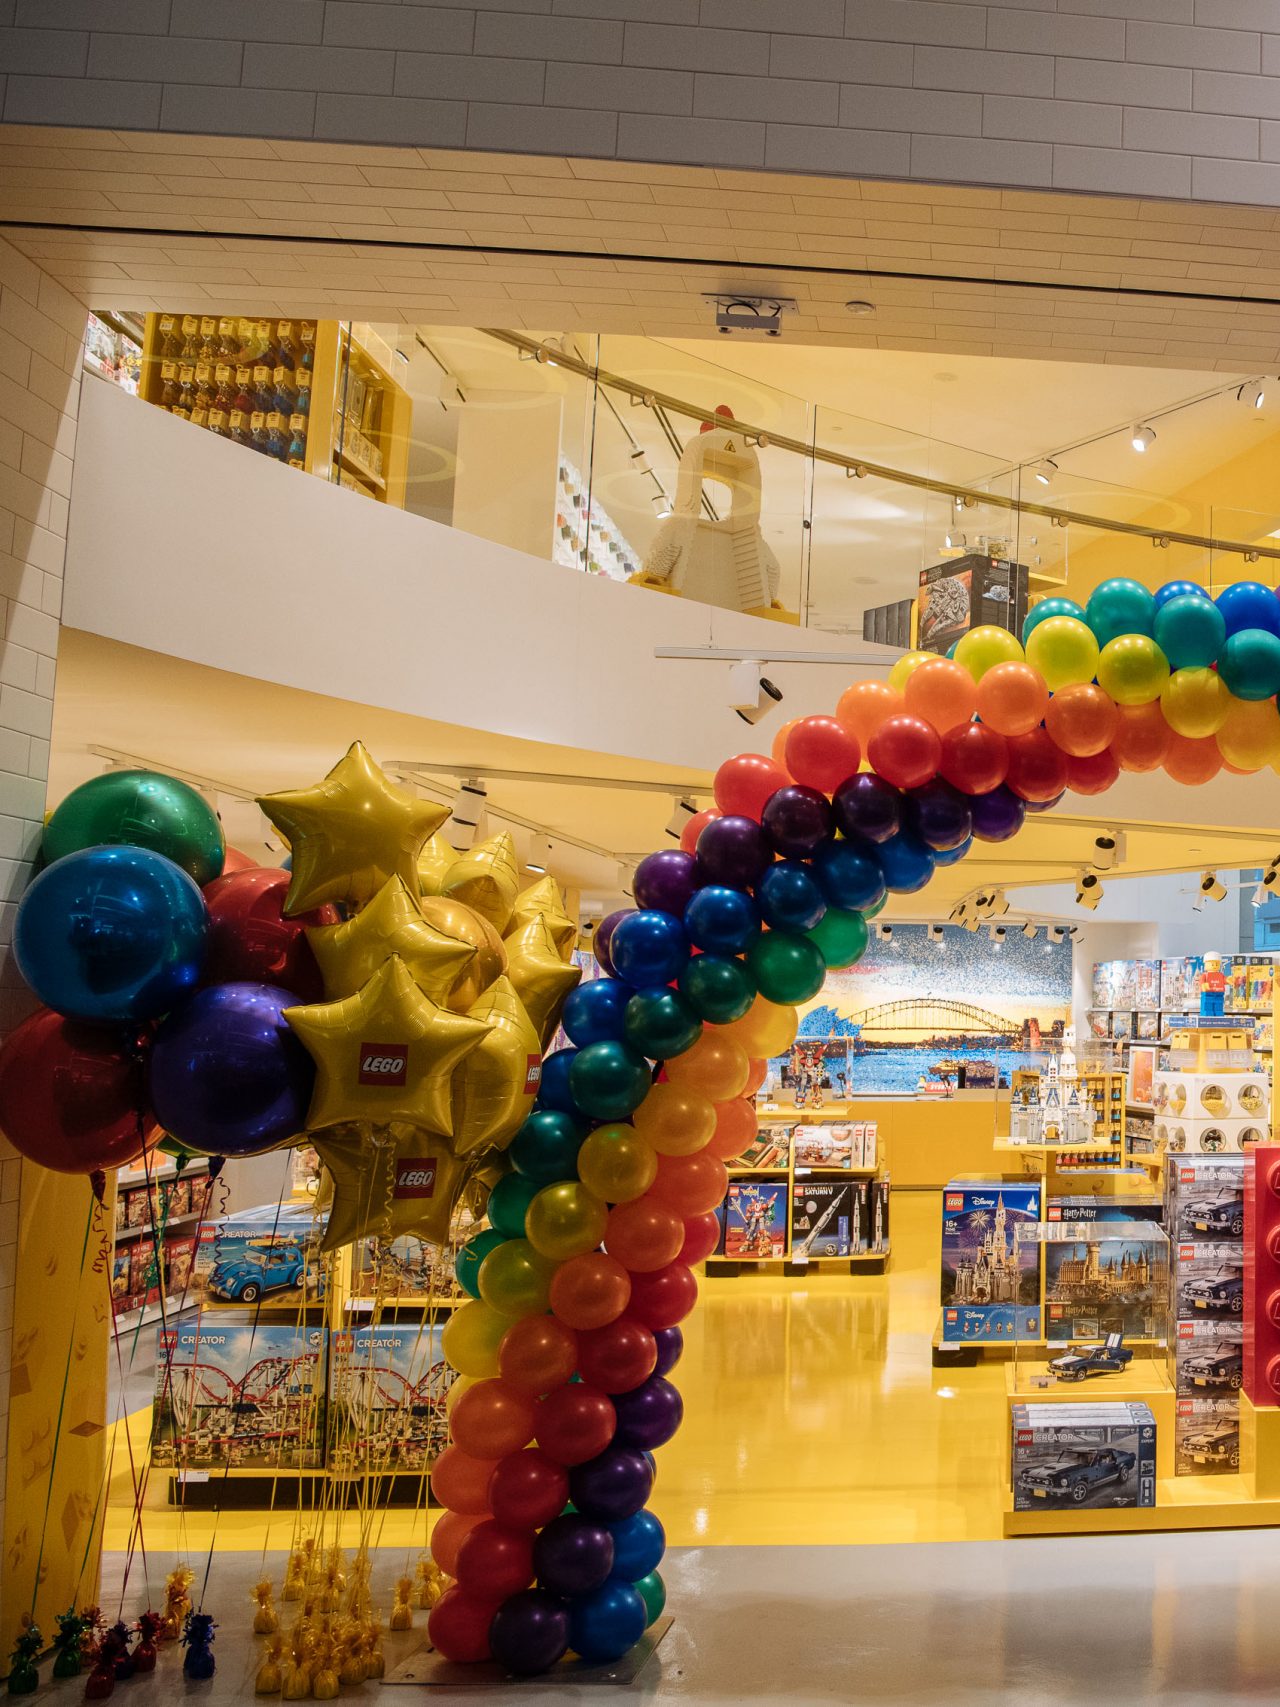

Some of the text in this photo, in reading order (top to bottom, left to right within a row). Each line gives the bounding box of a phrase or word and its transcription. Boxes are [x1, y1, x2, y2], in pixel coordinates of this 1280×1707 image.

[362, 1056, 404, 1074] LEGO
[527, 1066, 541, 1081] LEGO
[399, 1170, 433, 1186] LEGO
[971, 1196, 995, 1207] Disney
[946, 1220, 958, 1228] 16+
[219, 1230, 257, 1239] CREATOR
[181, 1335, 226, 1344] CREATOR
[357, 1339, 402, 1348] CREATOR
[1035, 1433, 1074, 1441] CREATOR
